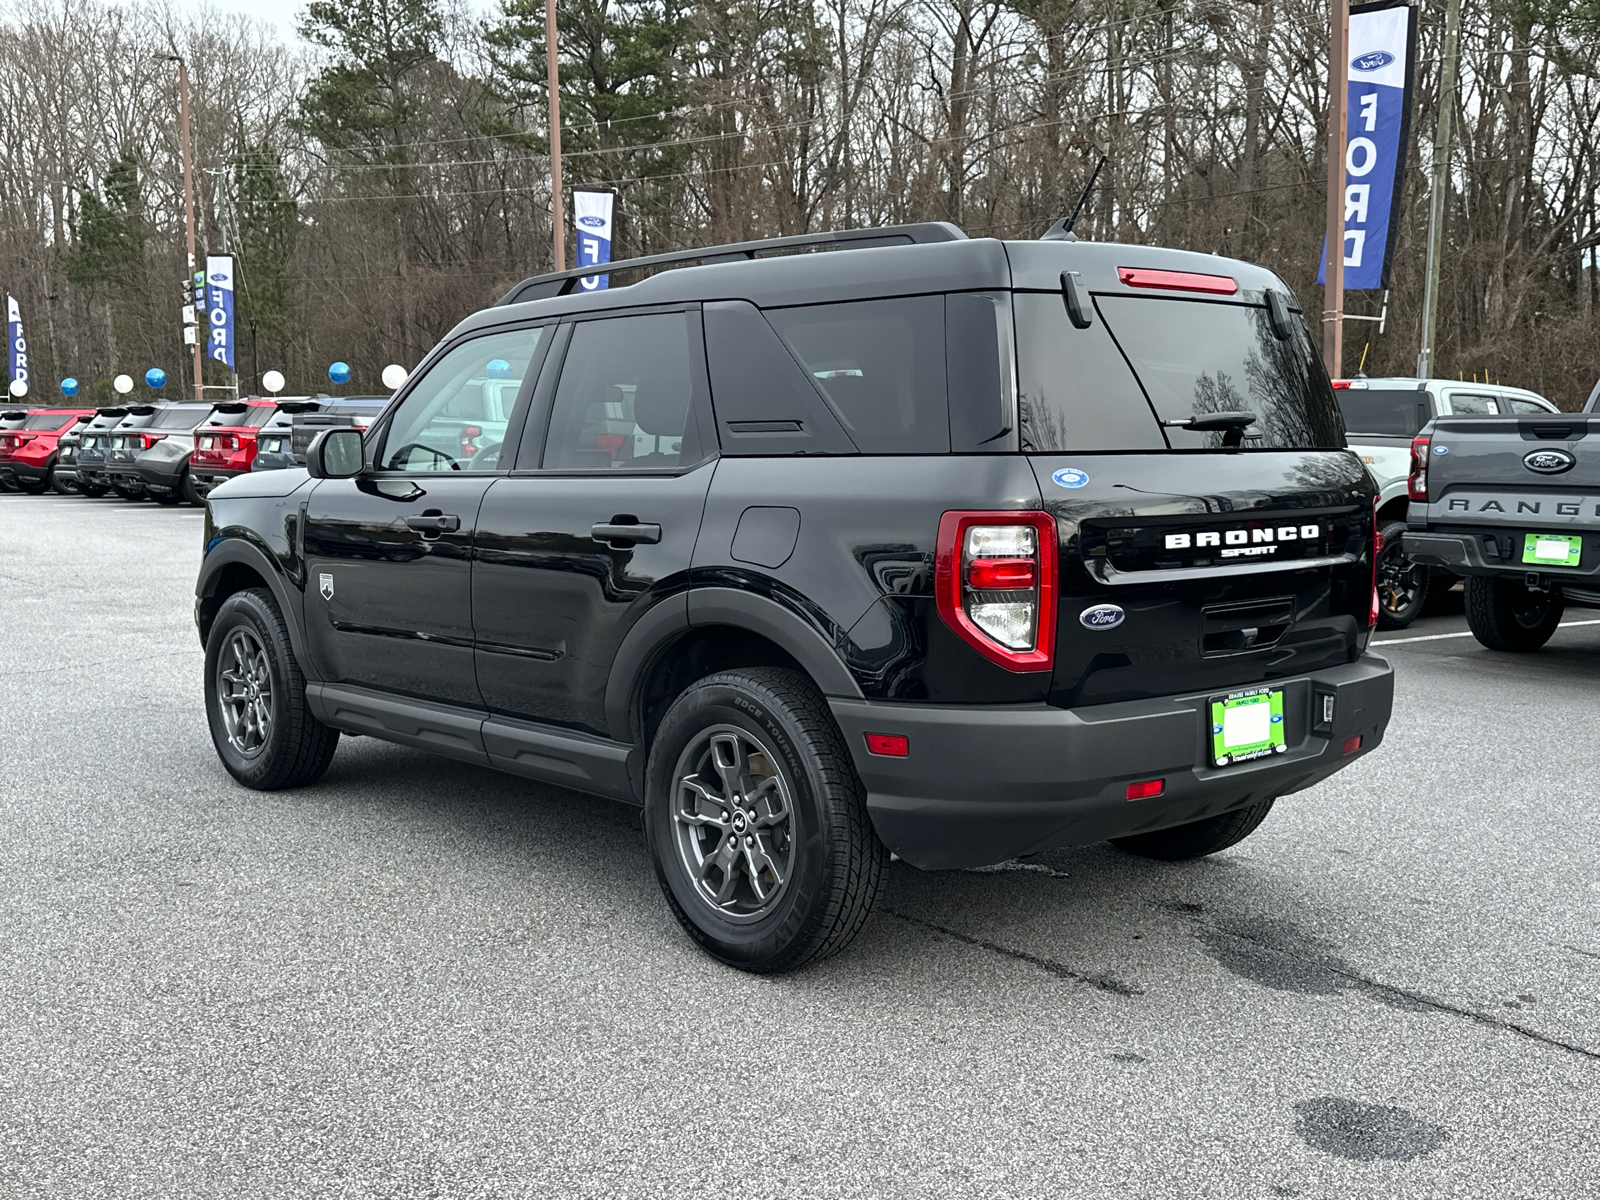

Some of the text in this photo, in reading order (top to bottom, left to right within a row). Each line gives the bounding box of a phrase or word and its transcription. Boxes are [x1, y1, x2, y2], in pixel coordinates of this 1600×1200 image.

[15, 323, 28, 382] FORD
[1533, 455, 1559, 467] Ford
[1448, 499, 1600, 516] RANG
[1165, 525, 1319, 549] BRONCO
[1221, 545, 1278, 557] SPORT
[1091, 609, 1117, 625] Ford
[734, 697, 763, 718] EDGE
[766, 720, 802, 778] TOURING
